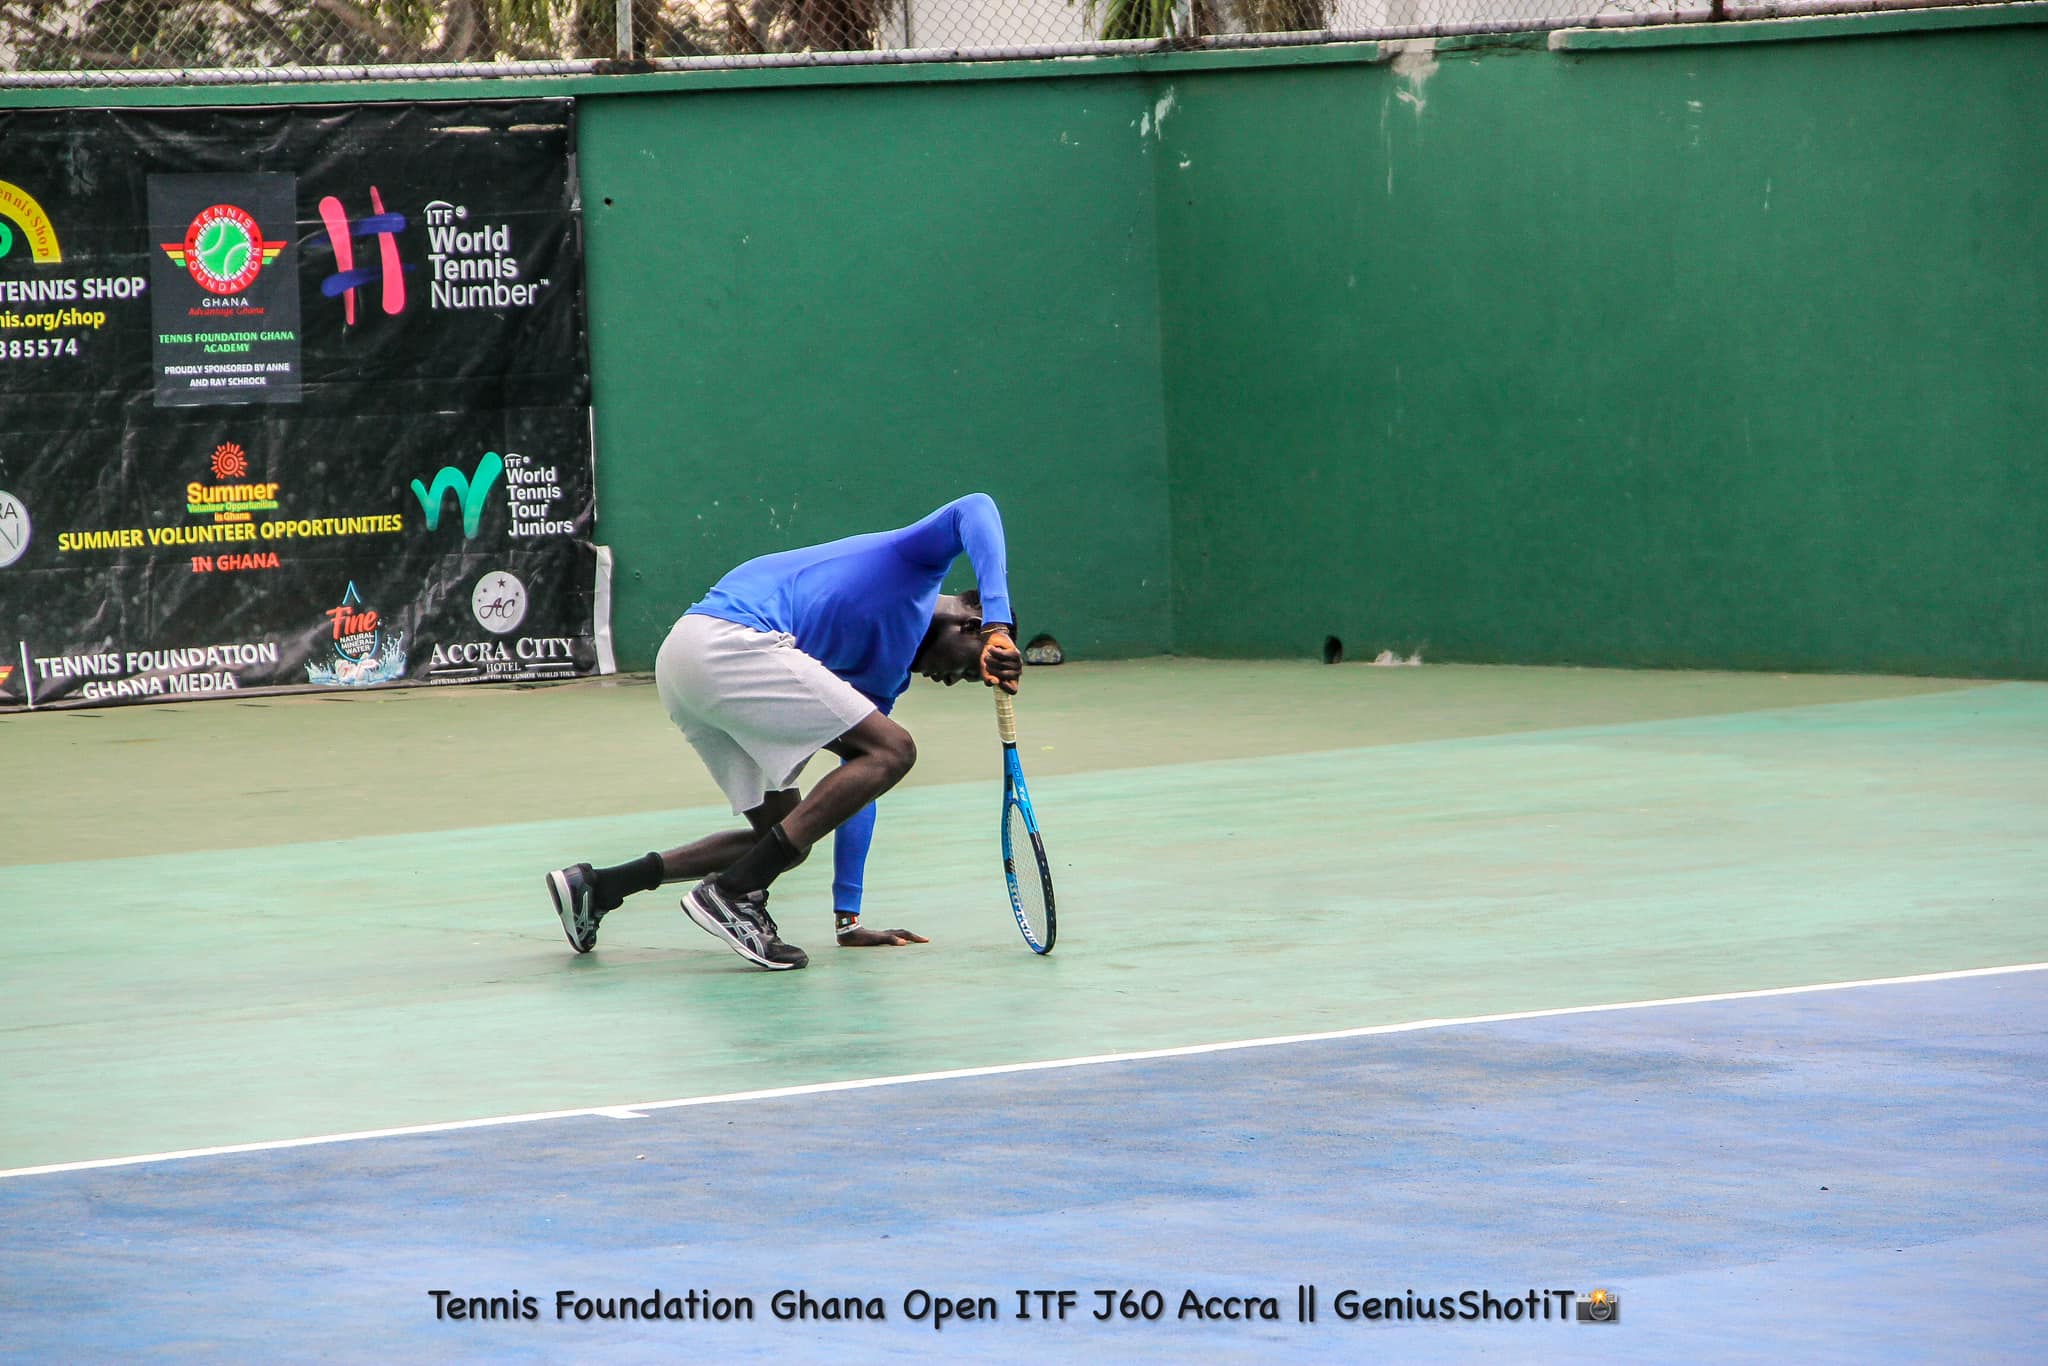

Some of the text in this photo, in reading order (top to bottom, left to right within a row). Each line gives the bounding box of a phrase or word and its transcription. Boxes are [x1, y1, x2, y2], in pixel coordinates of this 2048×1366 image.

[193, 207, 253, 229] TENNIS
[426, 209, 453, 225] ITF
[31, 216, 50, 257] Shop
[428, 224, 509, 253] World
[186, 247, 260, 292] FOUNDATION
[428, 252, 518, 280] Tennis
[82, 277, 146, 299] SHOP
[202, 297, 249, 307] GHANA
[236, 306, 265, 316] Ghana
[159, 330, 294, 343] TENNIS FOUNDATION GHANA
[203, 343, 250, 353] ACADEMY
[165, 362, 290, 375] PROUDLY SPONSORED BY ANNE
[189, 376, 266, 387] AND RAY SCHROCK
[504, 458, 521, 468] ITF
[506, 466, 556, 484] World
[187, 482, 280, 504] Summer
[506, 483, 562, 501] Tennis
[187, 500, 279, 513] Volunteer Opportunities
[507, 501, 548, 518] Tour
[224, 512, 252, 522] Ghana
[58, 514, 402, 551] SUMMER VOLUNTEER OPPORTUNITIES
[508, 518, 574, 536] Juniors
[191, 552, 280, 573] IN GHANA
[325, 606, 378, 641] Fine
[340, 632, 375, 644] NATURAL
[341, 638, 375, 649] MINERAL
[345, 645, 371, 654] WATER
[34, 643, 278, 679] TENNIS FOUNDATION
[486, 662, 521, 673] HOTEL
[83, 672, 239, 699] GHANA MEDIA
